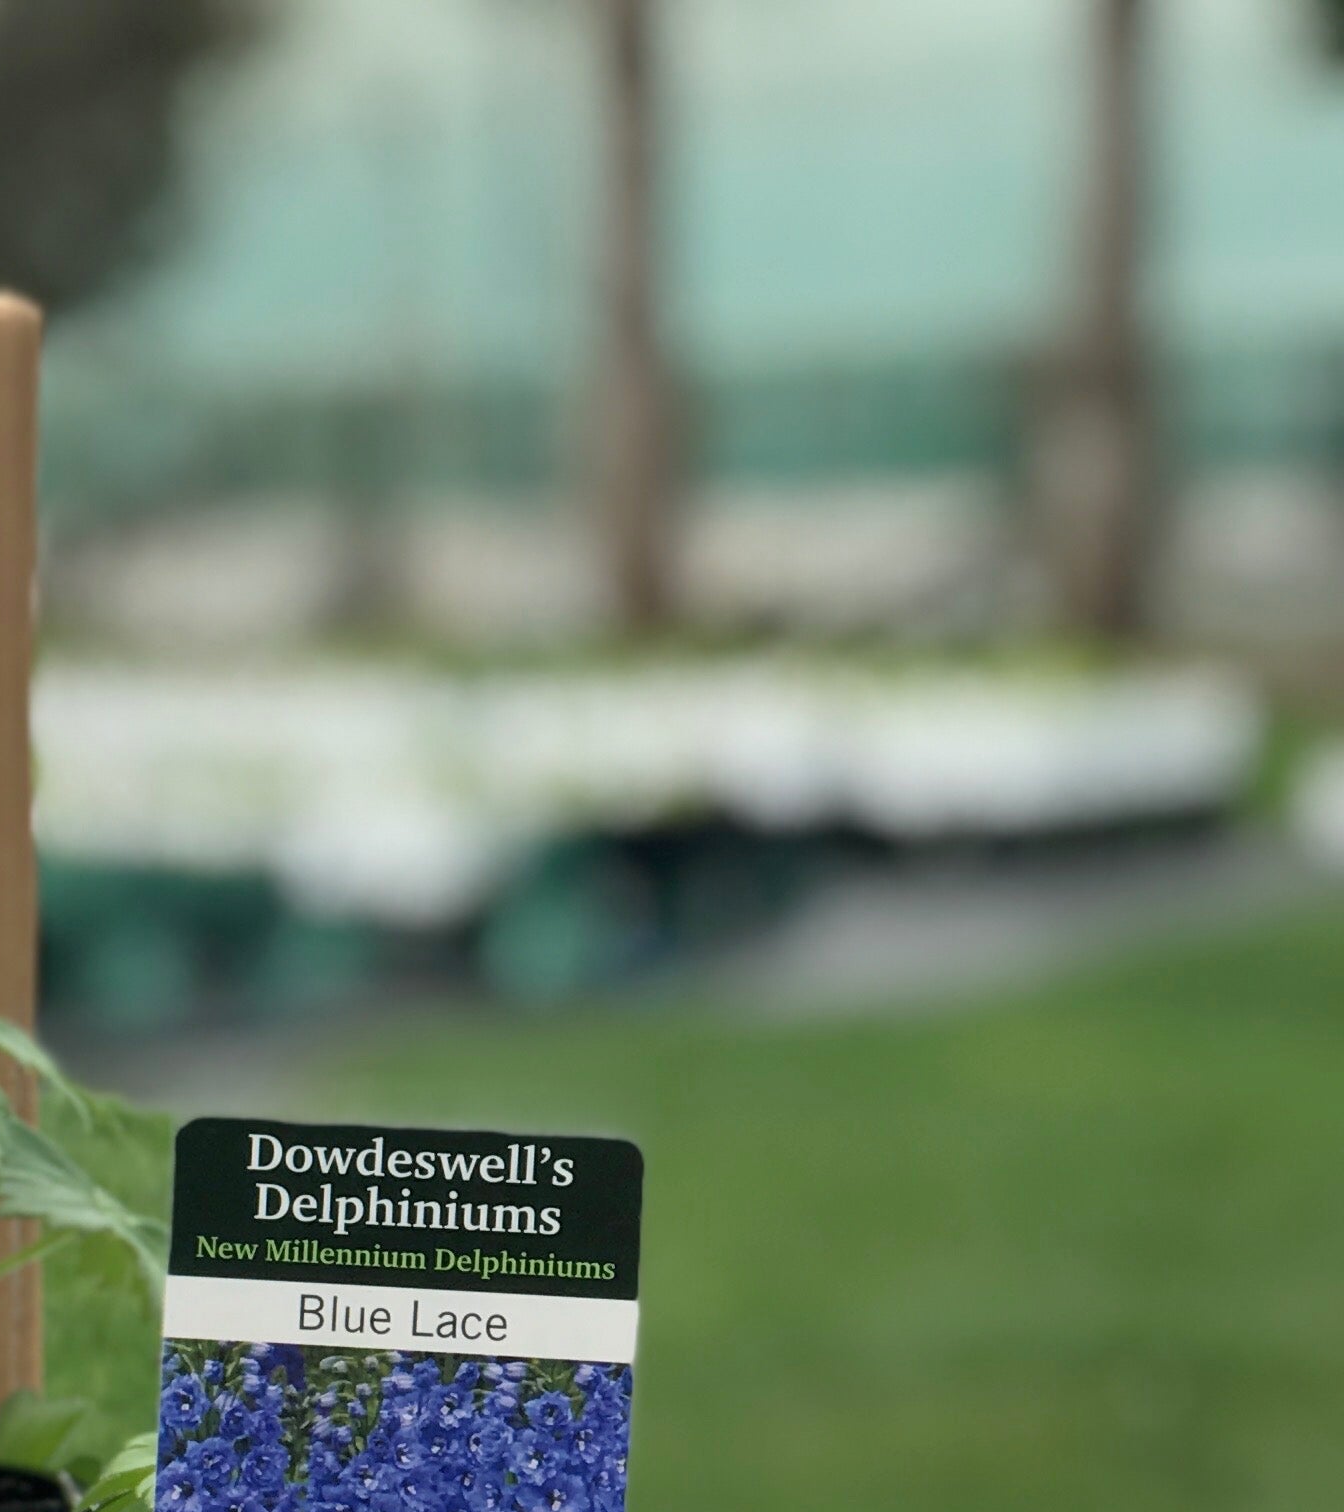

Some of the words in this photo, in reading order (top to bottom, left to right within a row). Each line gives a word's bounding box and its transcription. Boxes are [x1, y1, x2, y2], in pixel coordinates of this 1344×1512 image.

[246, 1133, 575, 1187] Dowdeswell's
[254, 1183, 561, 1236] Delphiniums
[196, 1235, 259, 1261] New
[265, 1239, 427, 1270] Millennium
[434, 1246, 616, 1280] Delphiniums
[298, 1293, 392, 1335] Blue
[411, 1300, 509, 1342] Lace
